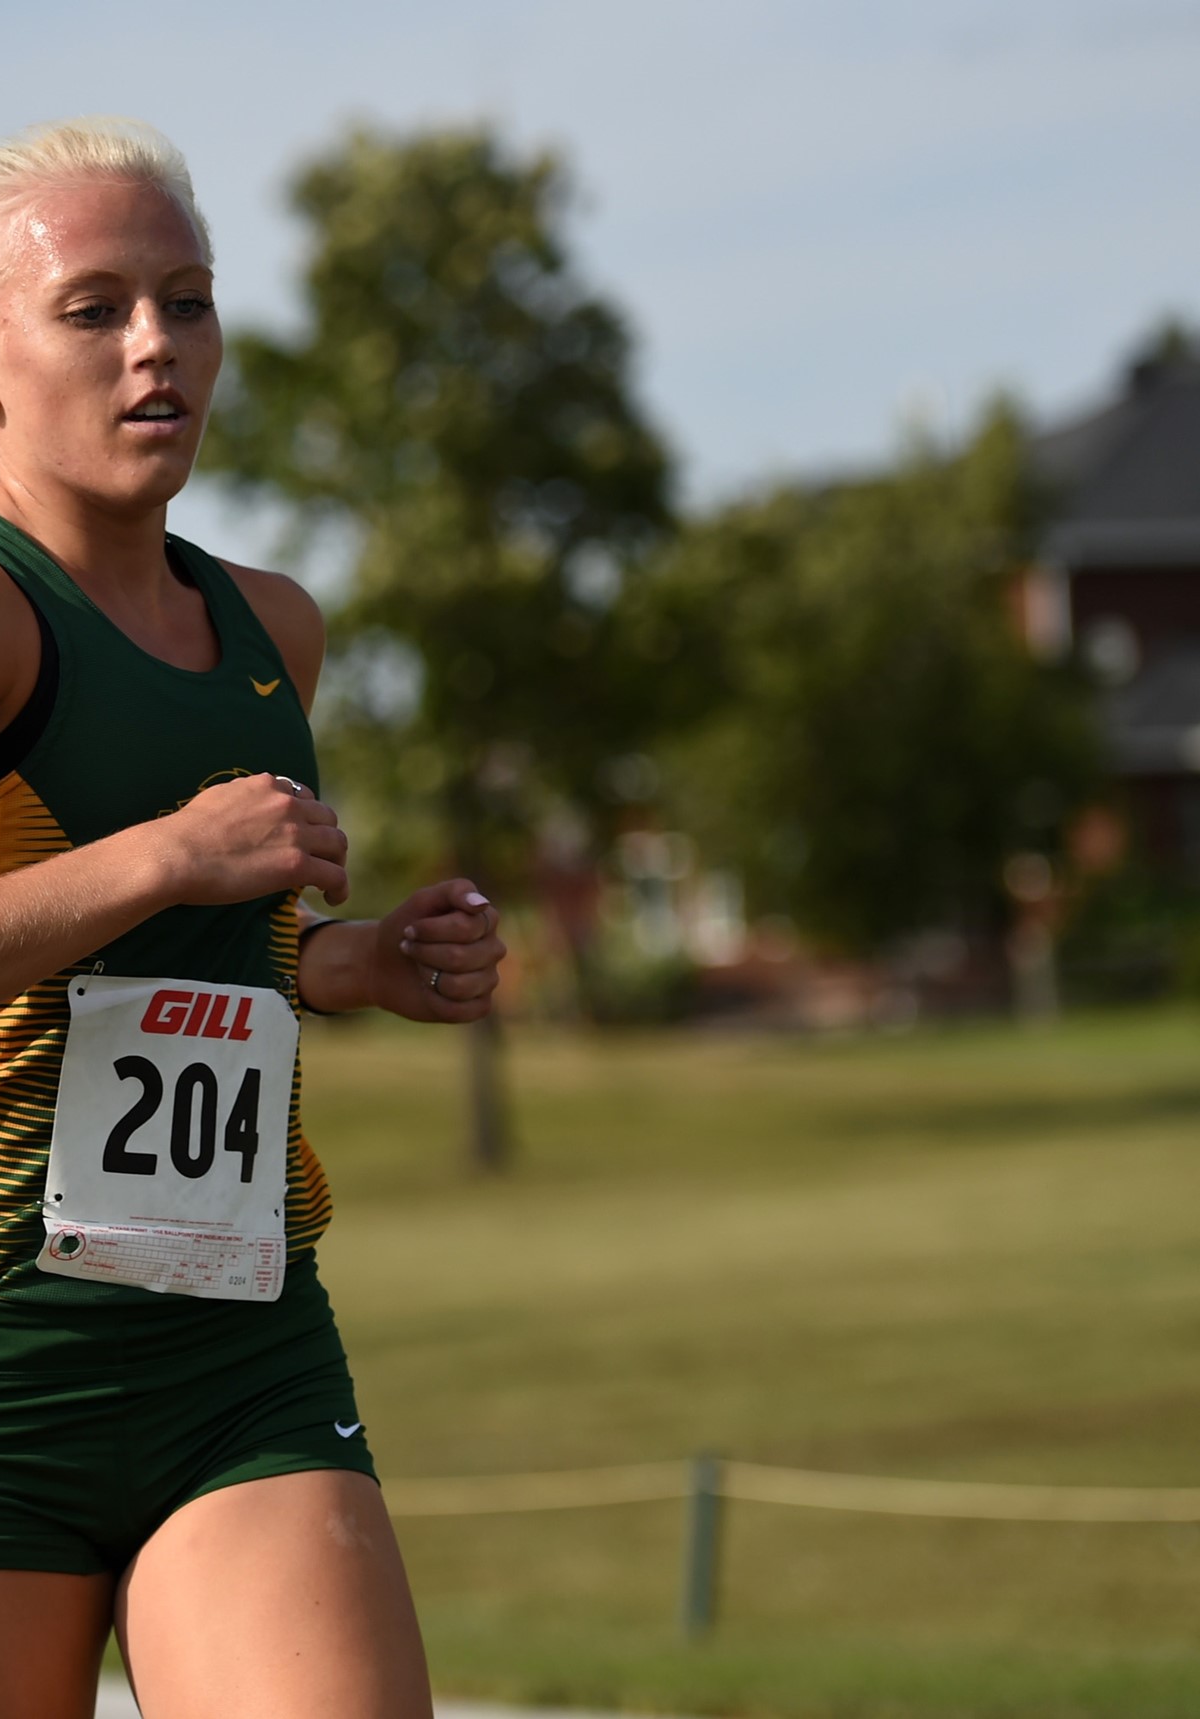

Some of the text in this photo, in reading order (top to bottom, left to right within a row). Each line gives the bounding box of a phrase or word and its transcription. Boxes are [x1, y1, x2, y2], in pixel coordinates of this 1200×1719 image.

[140, 989, 253, 1041] GILL
[102, 1055, 261, 1183] 204
[228, 1275, 246, 1286] 0204
